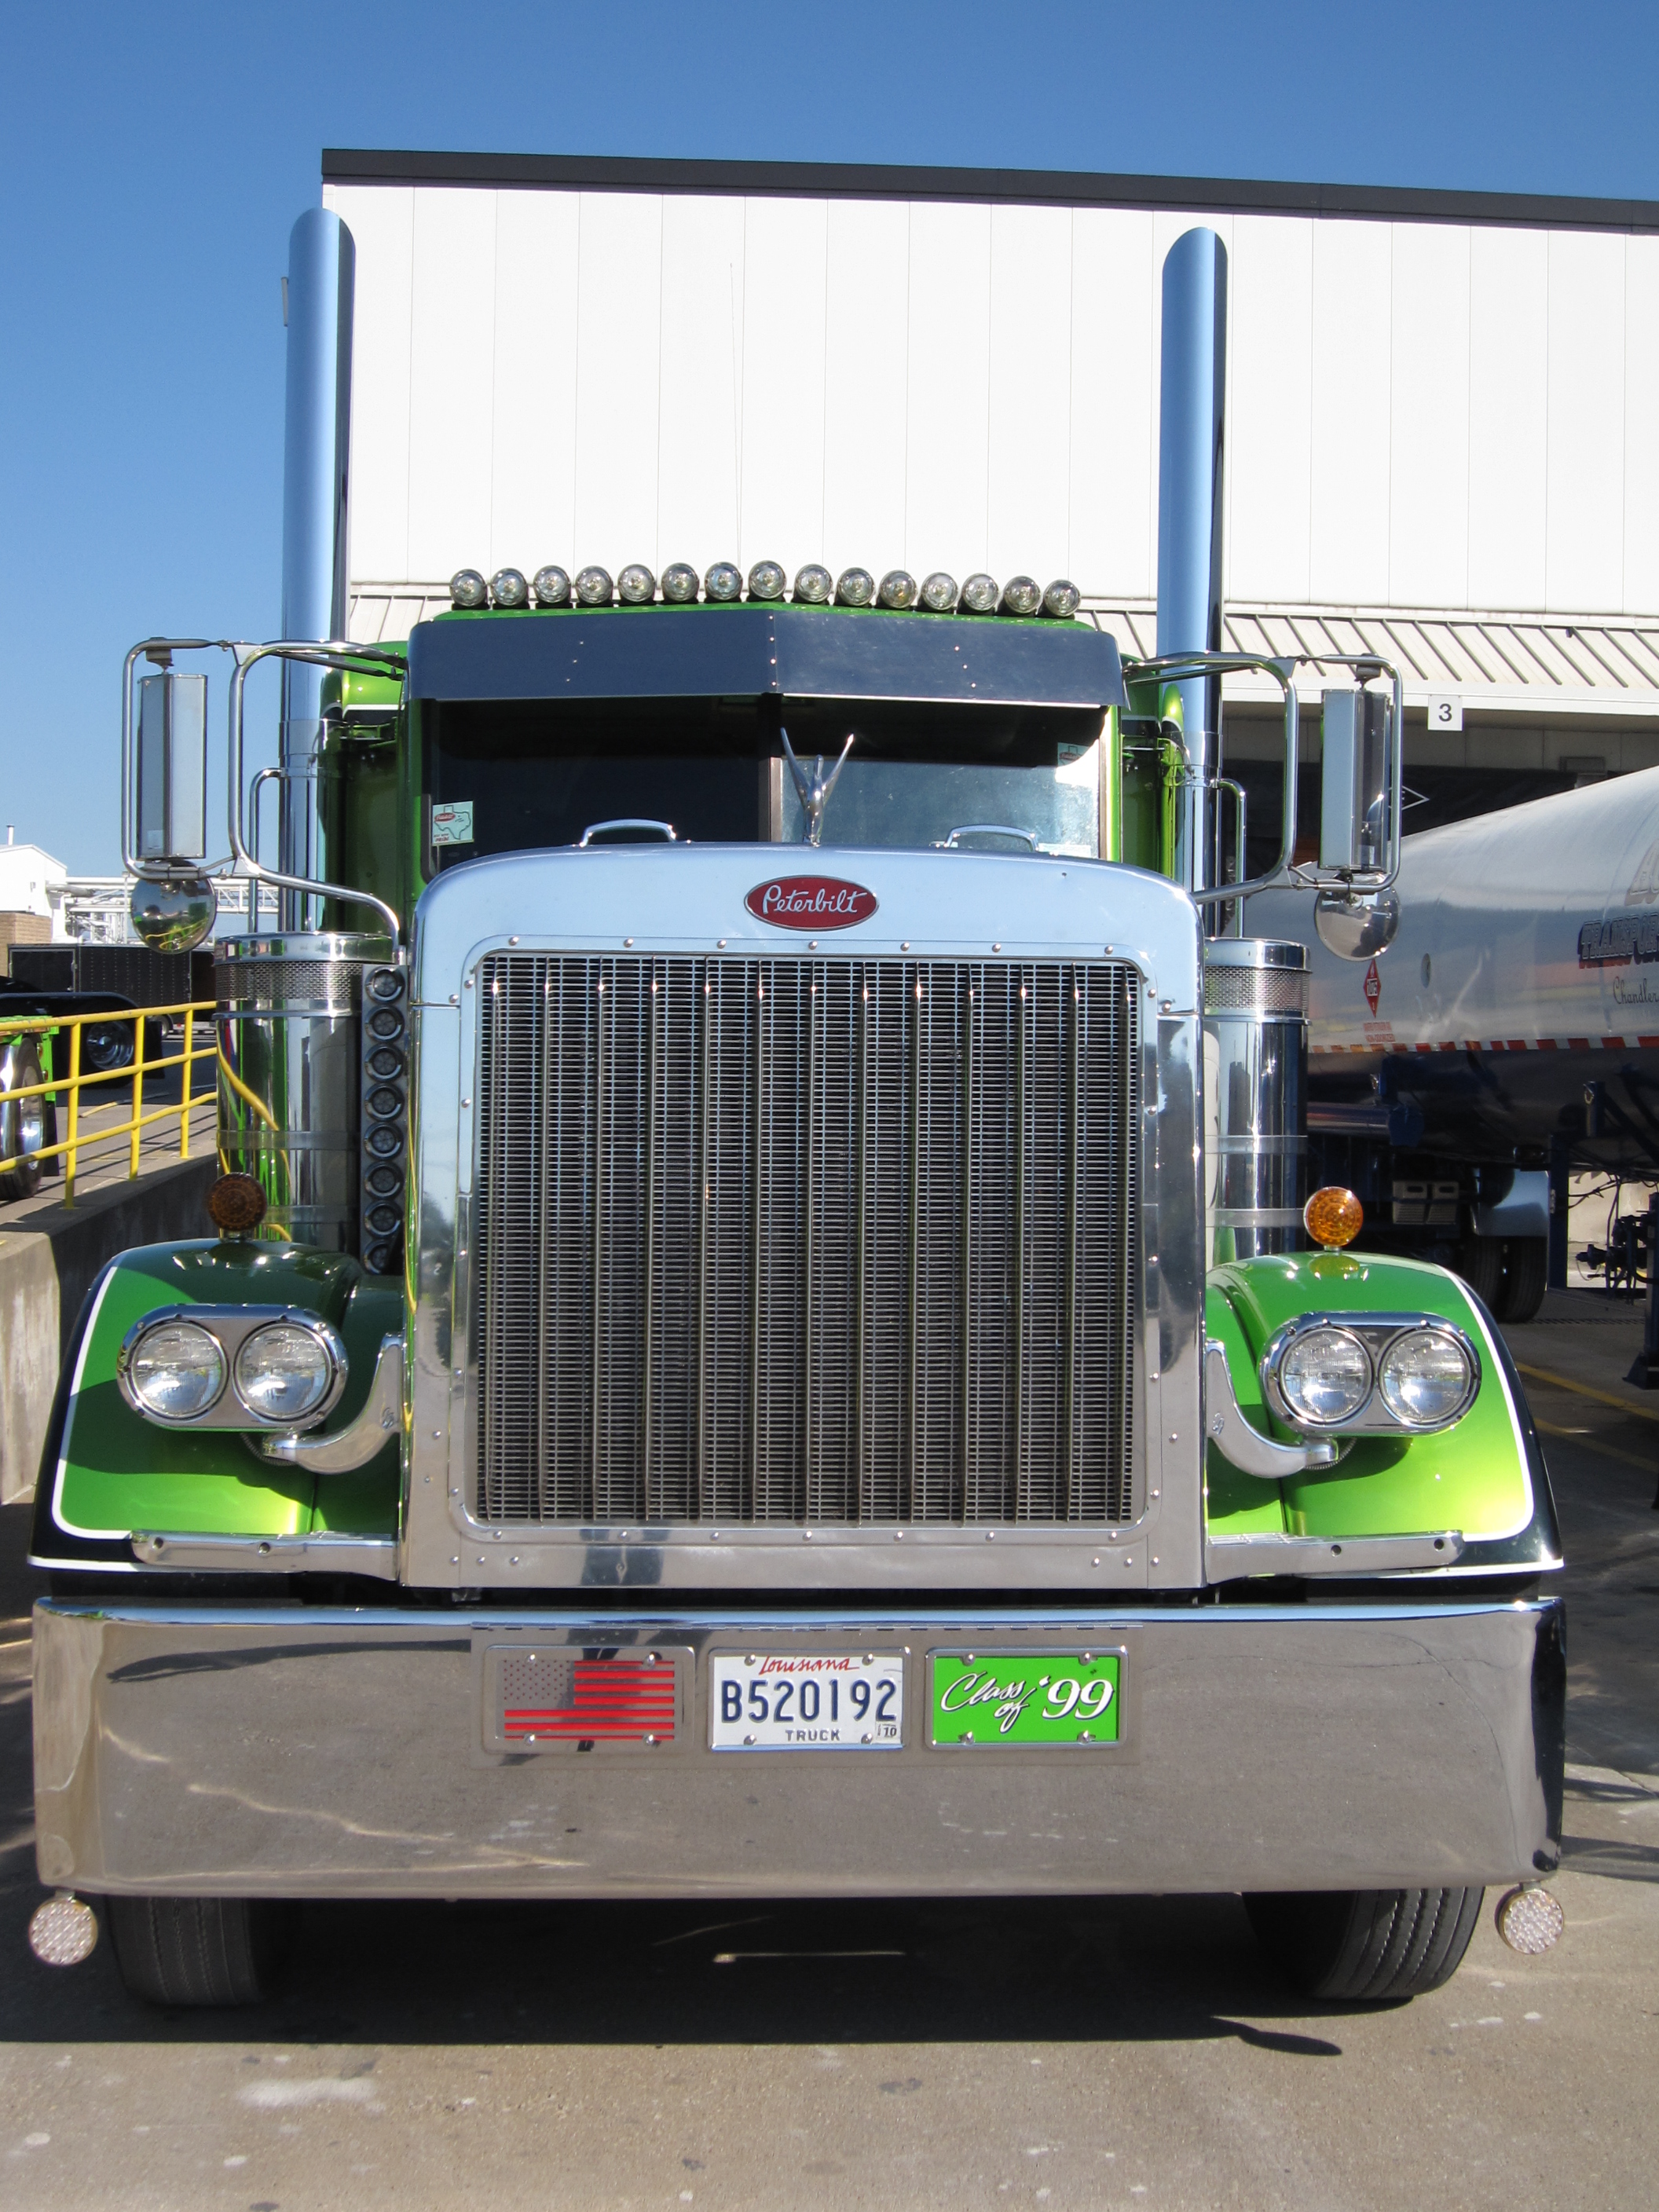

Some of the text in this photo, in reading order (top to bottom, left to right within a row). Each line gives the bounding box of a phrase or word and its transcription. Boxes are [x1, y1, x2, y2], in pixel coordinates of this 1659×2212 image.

[1438, 703, 1452, 722] 3
[762, 884, 867, 914] Peterbilt
[1579, 914, 1659, 963] TRANSPOR
[759, 1656, 859, 1675] Louisiana
[721, 1678, 897, 1723] B520192
[940, 1671, 1115, 1734] Class of '99
[786, 1729, 840, 1742] TRUCK
[884, 1727, 897, 1737] 10
